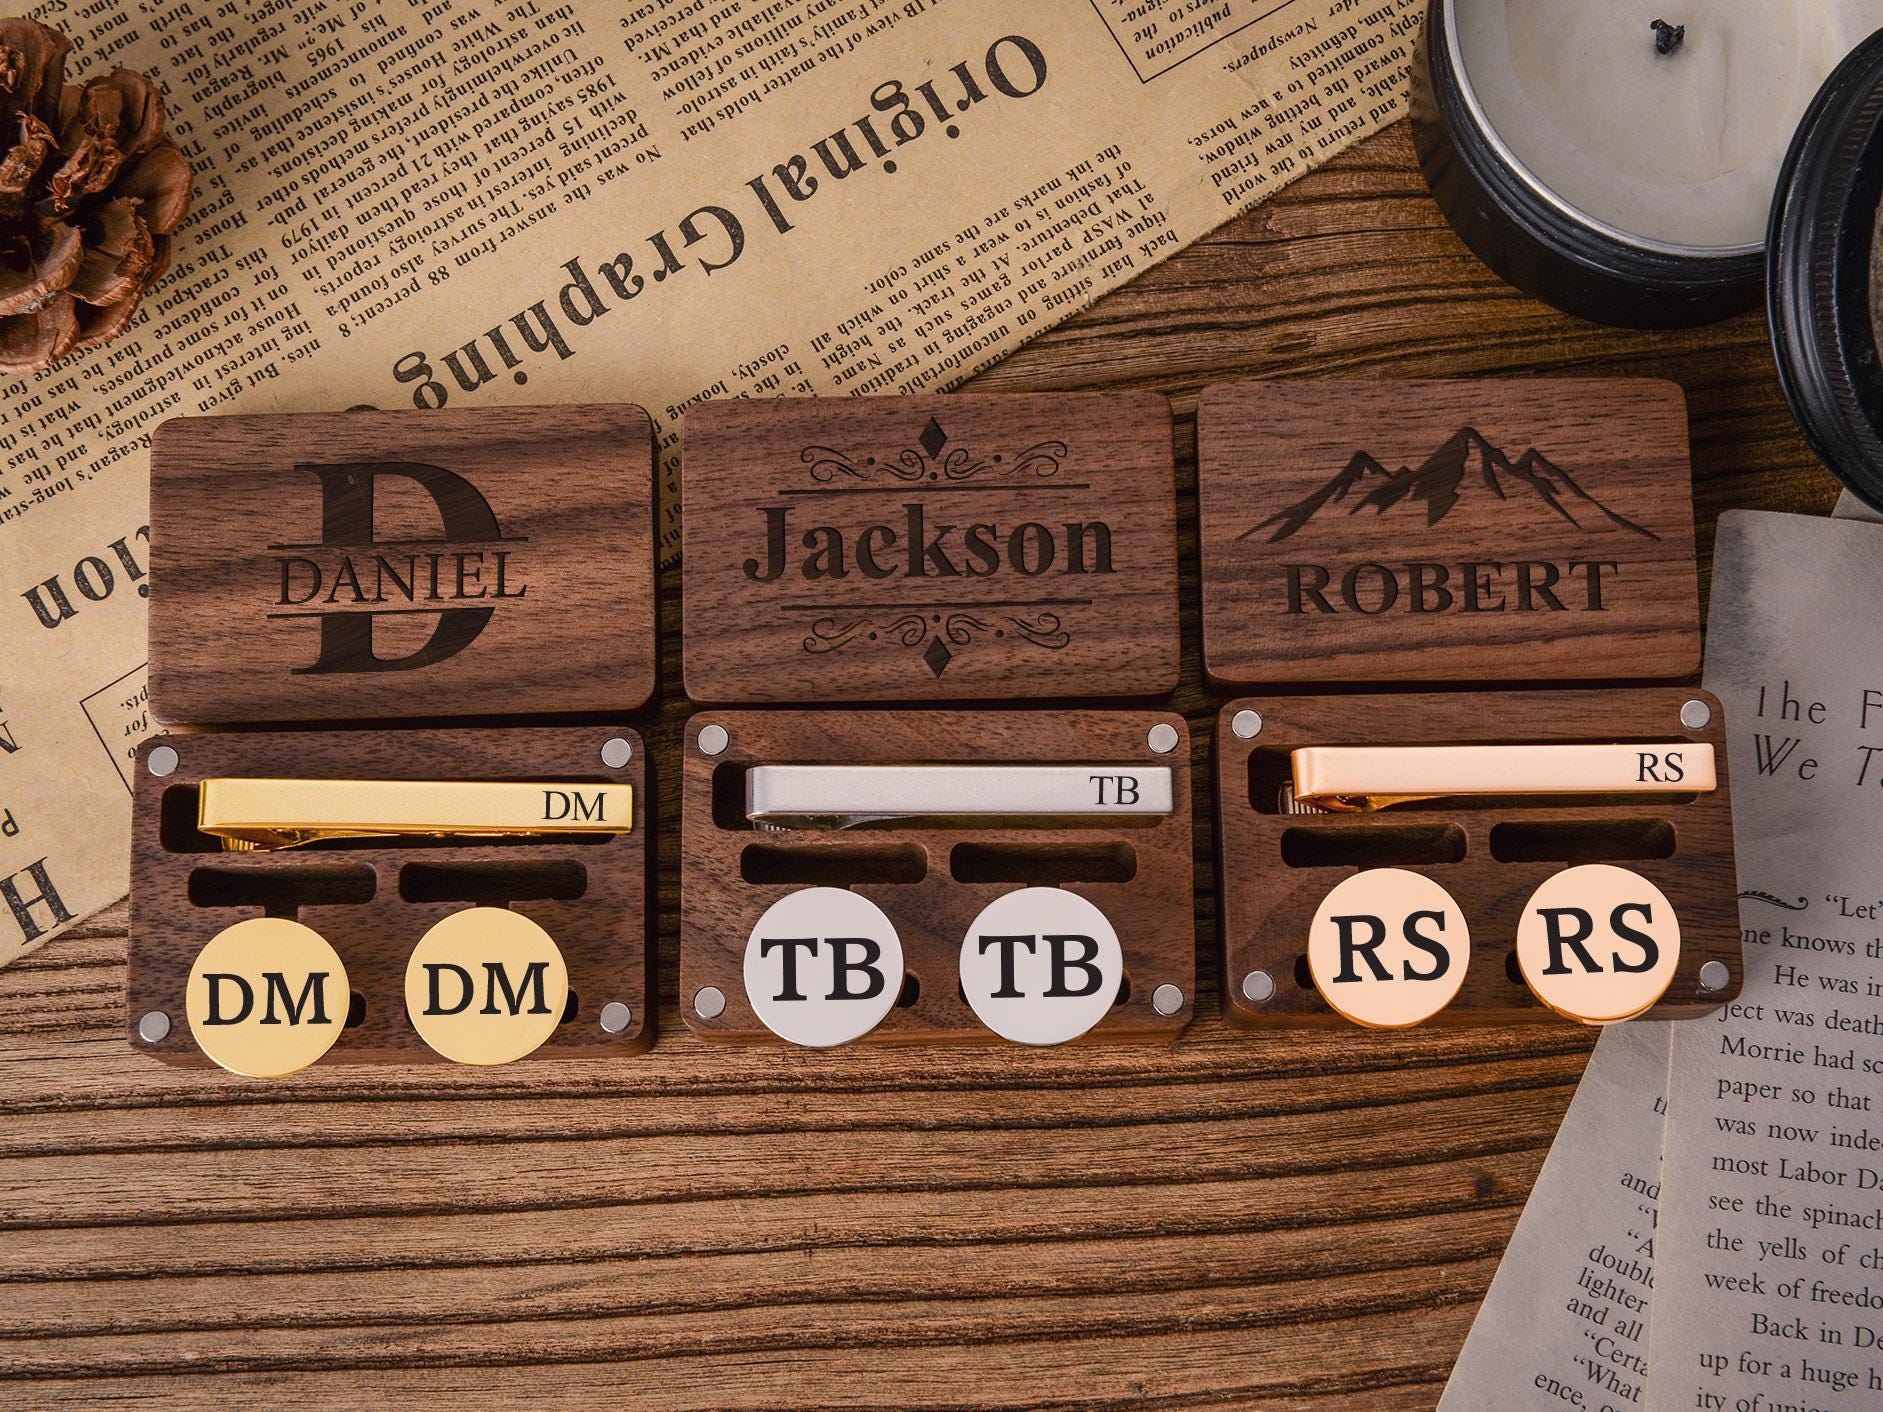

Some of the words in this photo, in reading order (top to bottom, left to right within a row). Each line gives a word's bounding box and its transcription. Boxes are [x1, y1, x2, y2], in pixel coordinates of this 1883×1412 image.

[533, 4, 574, 30] than
[561, 20, 586, 37] lic
[865, 11, 903, 38] view
[1144, 2, 1232, 60] publication
[452, 27, 528, 77] astrology
[734, 14, 804, 59] millions
[816, 42, 845, 62] the
[844, 32, 862, 52] of
[1222, 16, 1318, 73] Newspapers.
[432, 33, 560, 110] overwhelmingly
[713, 54, 733, 75] of
[1306, 33, 1384, 86] committed
[1352, 46, 1406, 84] toward
[420, 73, 446, 95] for
[662, 64, 714, 101] fellow
[762, 57, 817, 95] matter
[1287, 79, 1304, 93] to
[1323, 77, 1349, 97] the
[587, 91, 627, 118] with
[715, 88, 763, 121] holds
[1240, 96, 1273, 121] new
[1271, 90, 1283, 101] a
[347, 91, 414, 134] making
[371, 101, 431, 145] prefers
[562, 115, 584, 136] 15
[1263, 93, 1323, 130] betting
[558, 108, 637, 158] declining
[679, 115, 715, 142] that
[744, 34, 1047, 235] Original
[1187, 117, 1238, 146] horse,
[267, 129, 349, 178] decisions.
[490, 126, 557, 175] percent
[635, 143, 663, 164] No
[1095, 144, 1121, 163] the
[1198, 126, 1263, 164] window,
[300, 139, 370, 185] methods
[472, 167, 491, 188] of
[596, 162, 630, 186] was
[1064, 159, 1094, 182] ink
[485, 156, 553, 202] interest
[562, 183, 591, 204] the
[1013, 177, 1063, 211] marks
[1105, 177, 1146, 205] That
[256, 180, 299, 212] other
[421, 181, 468, 212] those
[465, 194, 487, 211] in
[1136, 192, 1154, 211] al
[498, 202, 557, 243] answer
[983, 207, 1010, 227] are
[1015, 200, 1103, 252] Debenture.
[1081, 208, 1134, 246] WASP
[325, 207, 416, 271] questioned
[954, 224, 981, 244] the
[453, 237, 497, 267] from
[911, 240, 951, 269] same
[990, 251, 1010, 272] At
[1020, 236, 1074, 277] parlor
[253, 264, 279, 286] for
[301, 265, 322, 281] in
[312, 253, 382, 296] reports,
[427, 265, 450, 286] 88
[863, 265, 907, 294] color.
[959, 267, 987, 287] the
[350, 276, 422, 327] percent;
[392, 205, 745, 409] Graphing
[907, 285, 955, 316] track.
[959, 272, 1012, 311] games
[153, 286, 240, 340] confidence
[247, 301, 302, 336] House
[876, 316, 903, 336] the
[913, 309, 953, 338] such
[105, 341, 143, 368] that
[820, 333, 874, 370] height
[887, 337, 906, 354] as
[81, 362, 105, 380] he
[104, 332, 244, 418] acknowledgment
[731, 343, 790, 380] closely,
[832, 352, 883, 385] Name
[47, 376, 80, 399] has
[13, 394, 43, 419] not
[65, 412, 102, 440] that
[7, 446, 40, 469] has
[40, 433, 65, 451] he
[742, 503, 1117, 583] Jackson
[275, 551, 528, 605] DANIEL
[1280, 560, 1618, 615] ROBERT
[1635, 751, 1684, 783] RS
[1752, 733, 1818, 780] We
[541, 789, 607, 822] DM
[1089, 775, 1140, 806] TB
[1330, 910, 1451, 983] RS
[1536, 902, 1660, 977] RS
[1780, 926, 1855, 956] knows
[760, 937, 885, 1002] TB
[978, 934, 1103, 999] TB
[1773, 964, 1810, 988] He
[1817, 975, 1859, 995] was
[202, 972, 332, 1026] DM
[422, 961, 552, 1016] DM
[1773, 1008, 1815, 1027] was
[1719, 1033, 1805, 1064] Morrie
[1812, 1044, 1855, 1071] had
[1715, 1078, 1783, 1103] paper
[1791, 1088, 1816, 1104] so
[1827, 1086, 1872, 1112] that
[1714, 1116, 1756, 1136] was
[1766, 1124, 1820, 1143] now
[1620, 1172, 1661, 1201] and
[1711, 1156, 1769, 1177] most
[1777, 1157, 1848, 1187] Labor
[1708, 1195, 1744, 1213] see
[1755, 1194, 1792, 1219] the
[1706, 1227, 1744, 1252] the
[1757, 1236, 1807, 1262] yells
[1821, 1243, 1851, 1265] of
[1575, 1266, 1649, 1314] lighter
[1703, 1271, 1766, 1295] week
[1776, 1277, 1806, 1300] of
[1565, 1297, 1610, 1326] and
[1613, 1319, 1644, 1343] all
[1749, 1312, 1809, 1341] Back
[1818, 1321, 1843, 1345] in
[1698, 1352, 1729, 1377] up
[1737, 1350, 1773, 1376] for
[1779, 1363, 1792, 1379] a
[1799, 1358, 1859, 1393] huge
[1735, 1392, 1765, 1411] of
